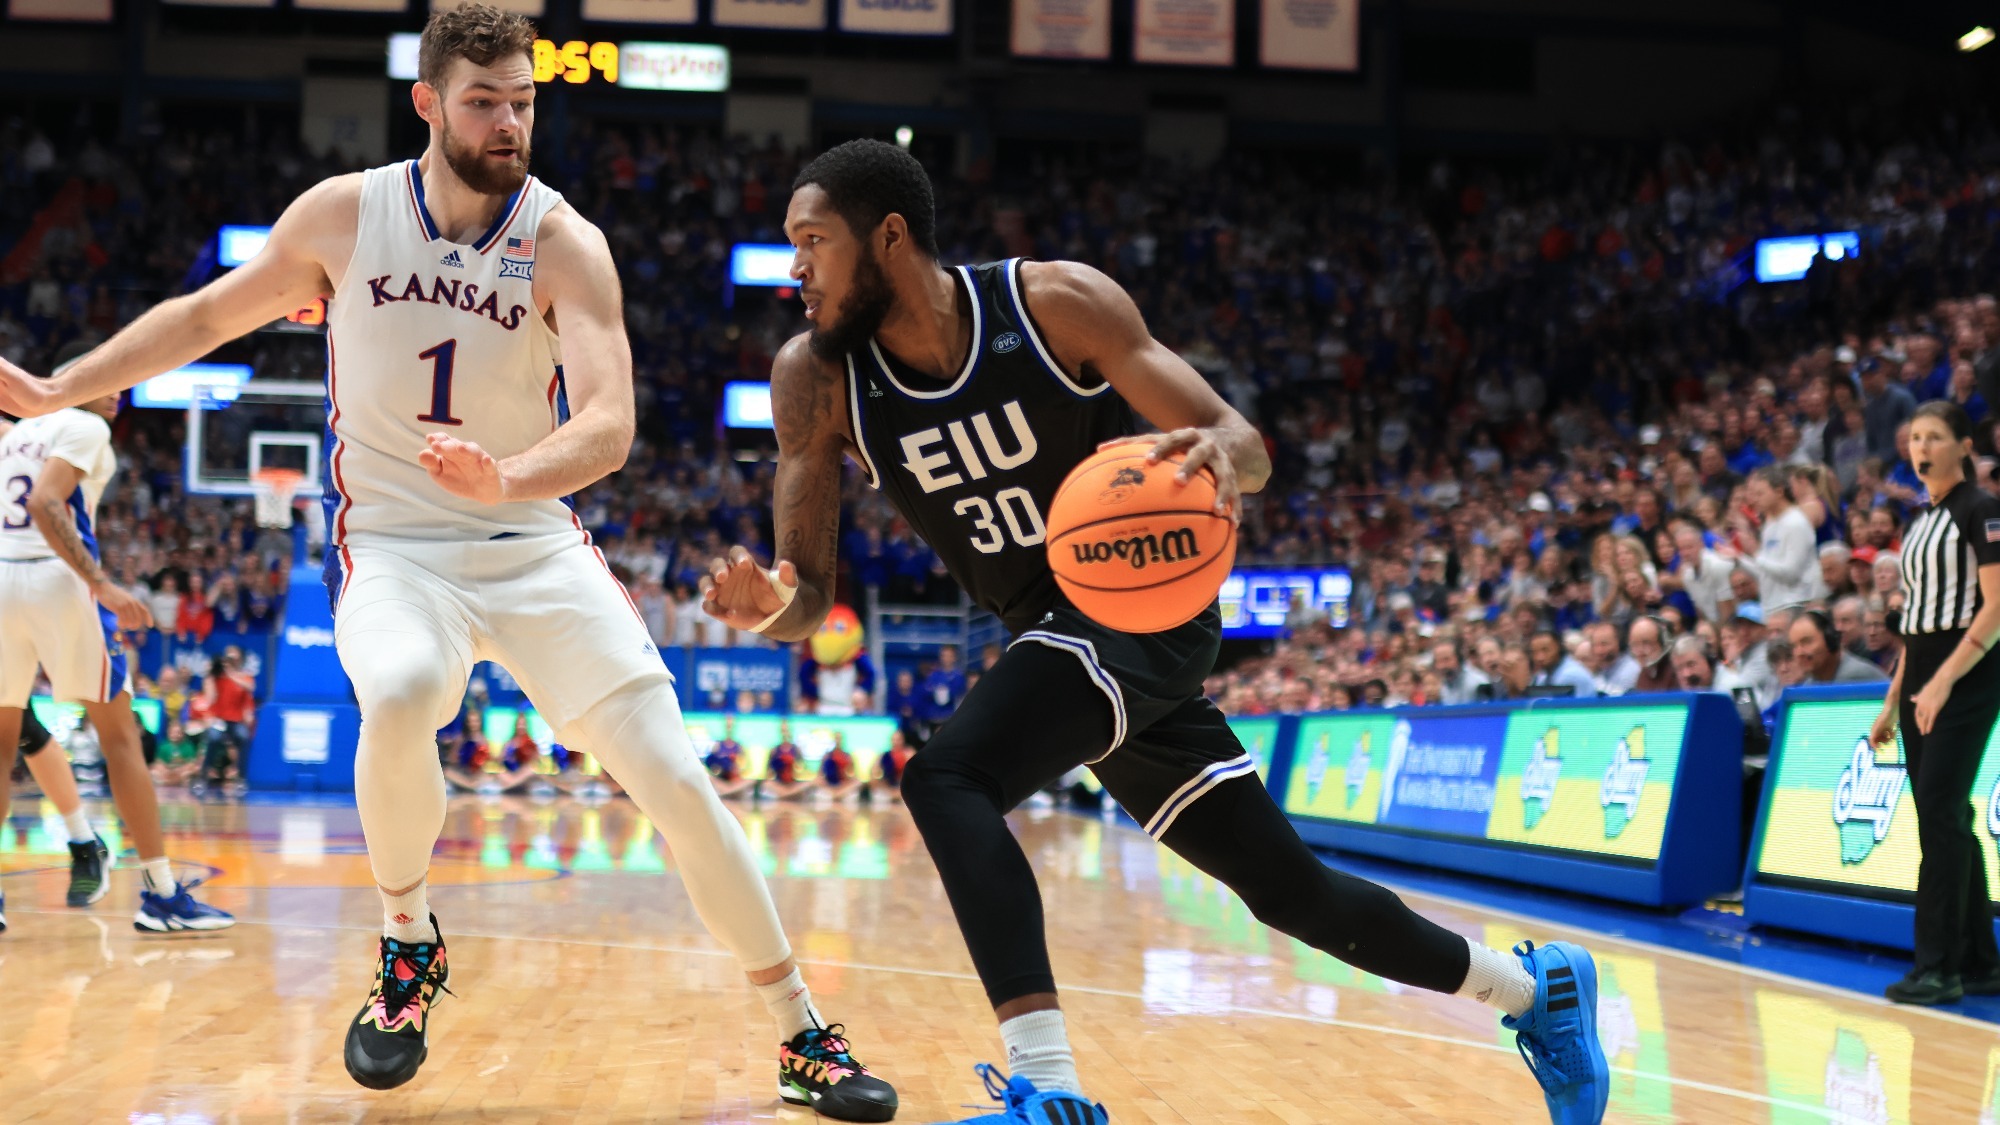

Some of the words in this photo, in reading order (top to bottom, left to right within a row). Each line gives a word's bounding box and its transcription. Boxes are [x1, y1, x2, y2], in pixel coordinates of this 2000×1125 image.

[440, 259, 464, 269] adidas
[500, 257, 534, 281] XII
[367, 272, 527, 331] KANSAS
[998, 336, 1016, 349] OVC
[417, 338, 463, 426] 1
[899, 399, 1038, 494] EIU
[3, 475, 33, 529] 3
[953, 486, 1047, 554] 30
[1072, 527, 1201, 570] Wilson
[1833, 737, 1907, 842] Starry
